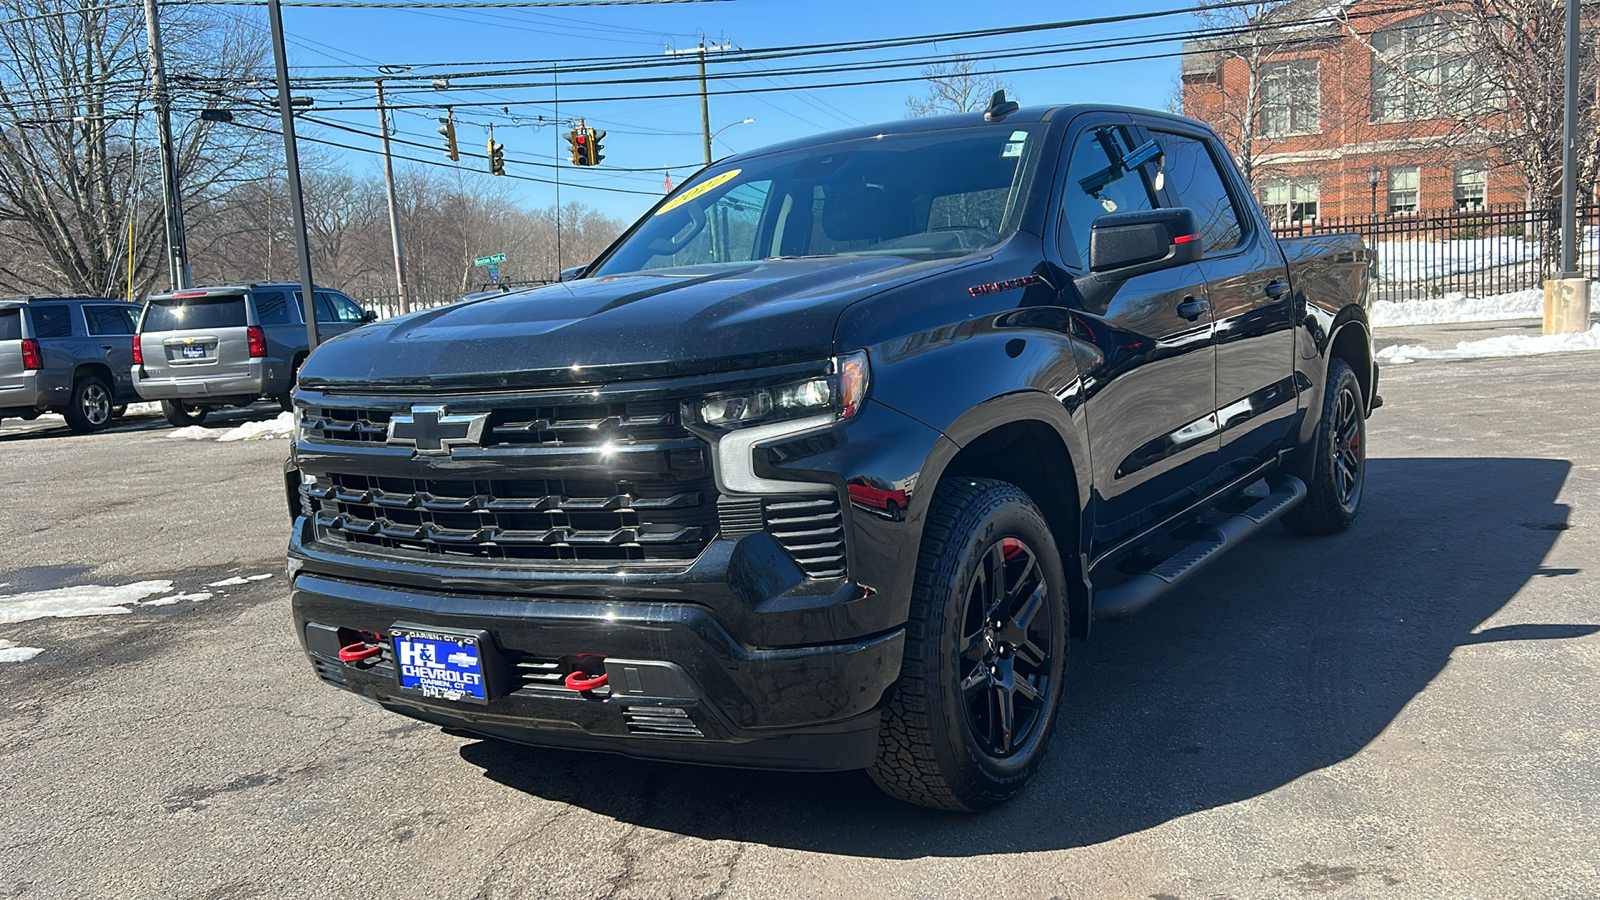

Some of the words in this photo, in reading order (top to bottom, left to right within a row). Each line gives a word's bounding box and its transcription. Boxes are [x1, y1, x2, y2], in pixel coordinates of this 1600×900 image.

[400, 641, 445, 669] H&L
[402, 665, 481, 685] CHEVROLET
[454, 682, 465, 690] CT
